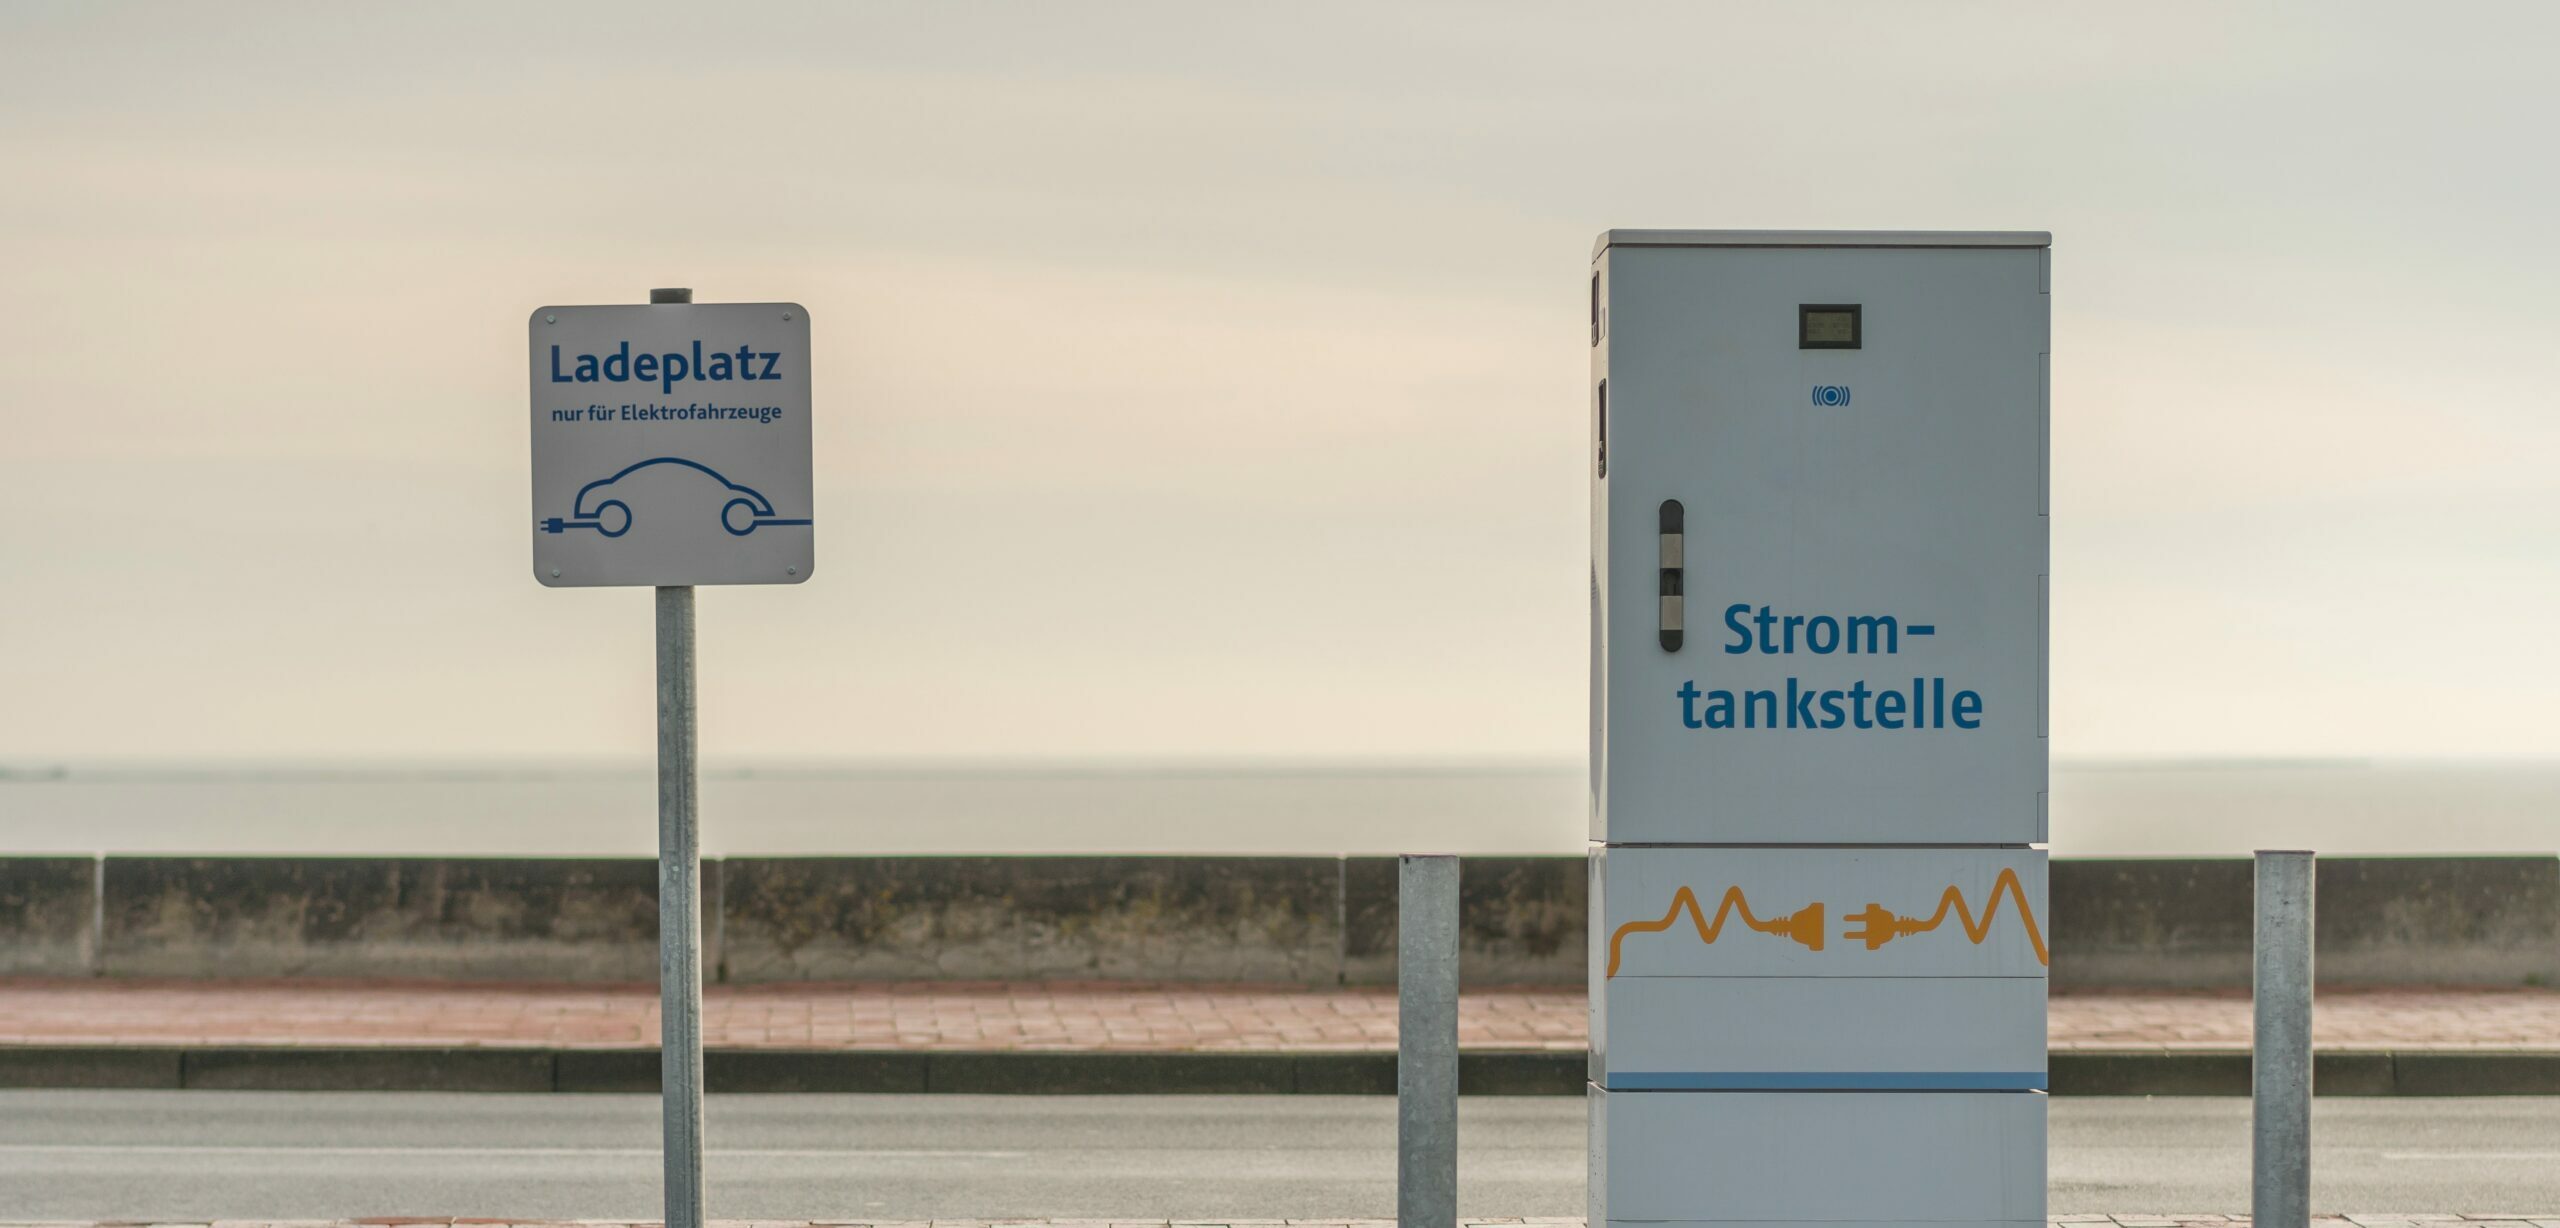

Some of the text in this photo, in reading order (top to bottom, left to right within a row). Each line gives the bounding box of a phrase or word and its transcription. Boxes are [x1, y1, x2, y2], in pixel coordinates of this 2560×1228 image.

[551, 340, 782, 394] Ladeplatz
[552, 403, 782, 424] nur für Elektrofahrzeuge
[1724, 603, 1935, 655] Strom-
[1676, 677, 1983, 730] tankstelle
